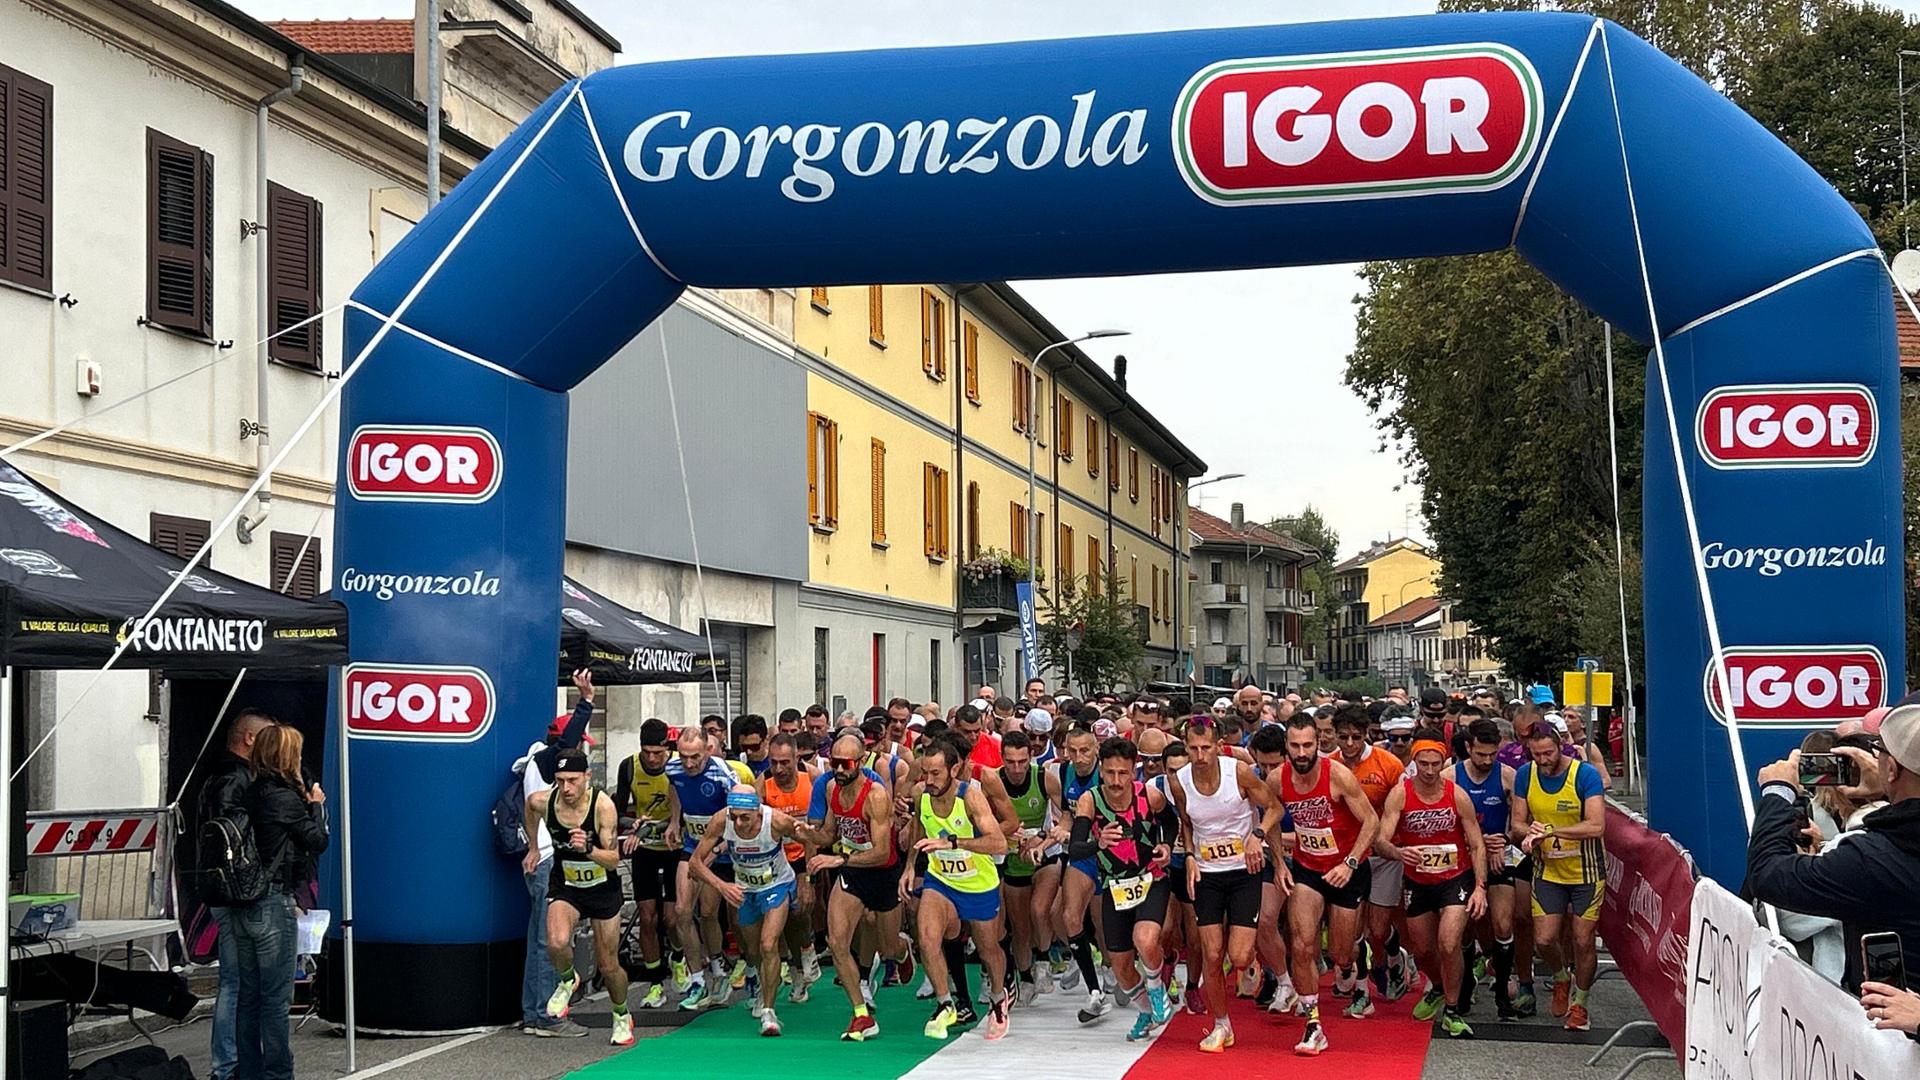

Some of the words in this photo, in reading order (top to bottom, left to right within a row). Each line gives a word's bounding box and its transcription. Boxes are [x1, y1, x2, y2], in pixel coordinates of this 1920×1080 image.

[1223, 76, 1490, 168] IGOR
[623, 89, 1149, 202] Gorgonzola
[1719, 404, 1860, 449] IGOR
[359, 442, 479, 485] IGOR
[1702, 538, 1886, 577] Gorgonzola
[341, 567, 500, 601] Gorgonzola
[29, 621, 56, 632] VALORE
[57, 621, 80, 632] DELLA
[133, 617, 264, 652] FONTANETO
[636, 648, 694, 673] FONTANETO
[1731, 665, 1871, 709] IGOR
[352, 681, 472, 723] IGOR
[688, 822, 709, 836] 19
[1300, 834, 1329, 849] 284
[1208, 844, 1237, 859] 181
[1423, 853, 1451, 867] 274
[575, 869, 595, 882] 10
[940, 859, 967, 874] 170
[1124, 884, 1144, 901] 36
